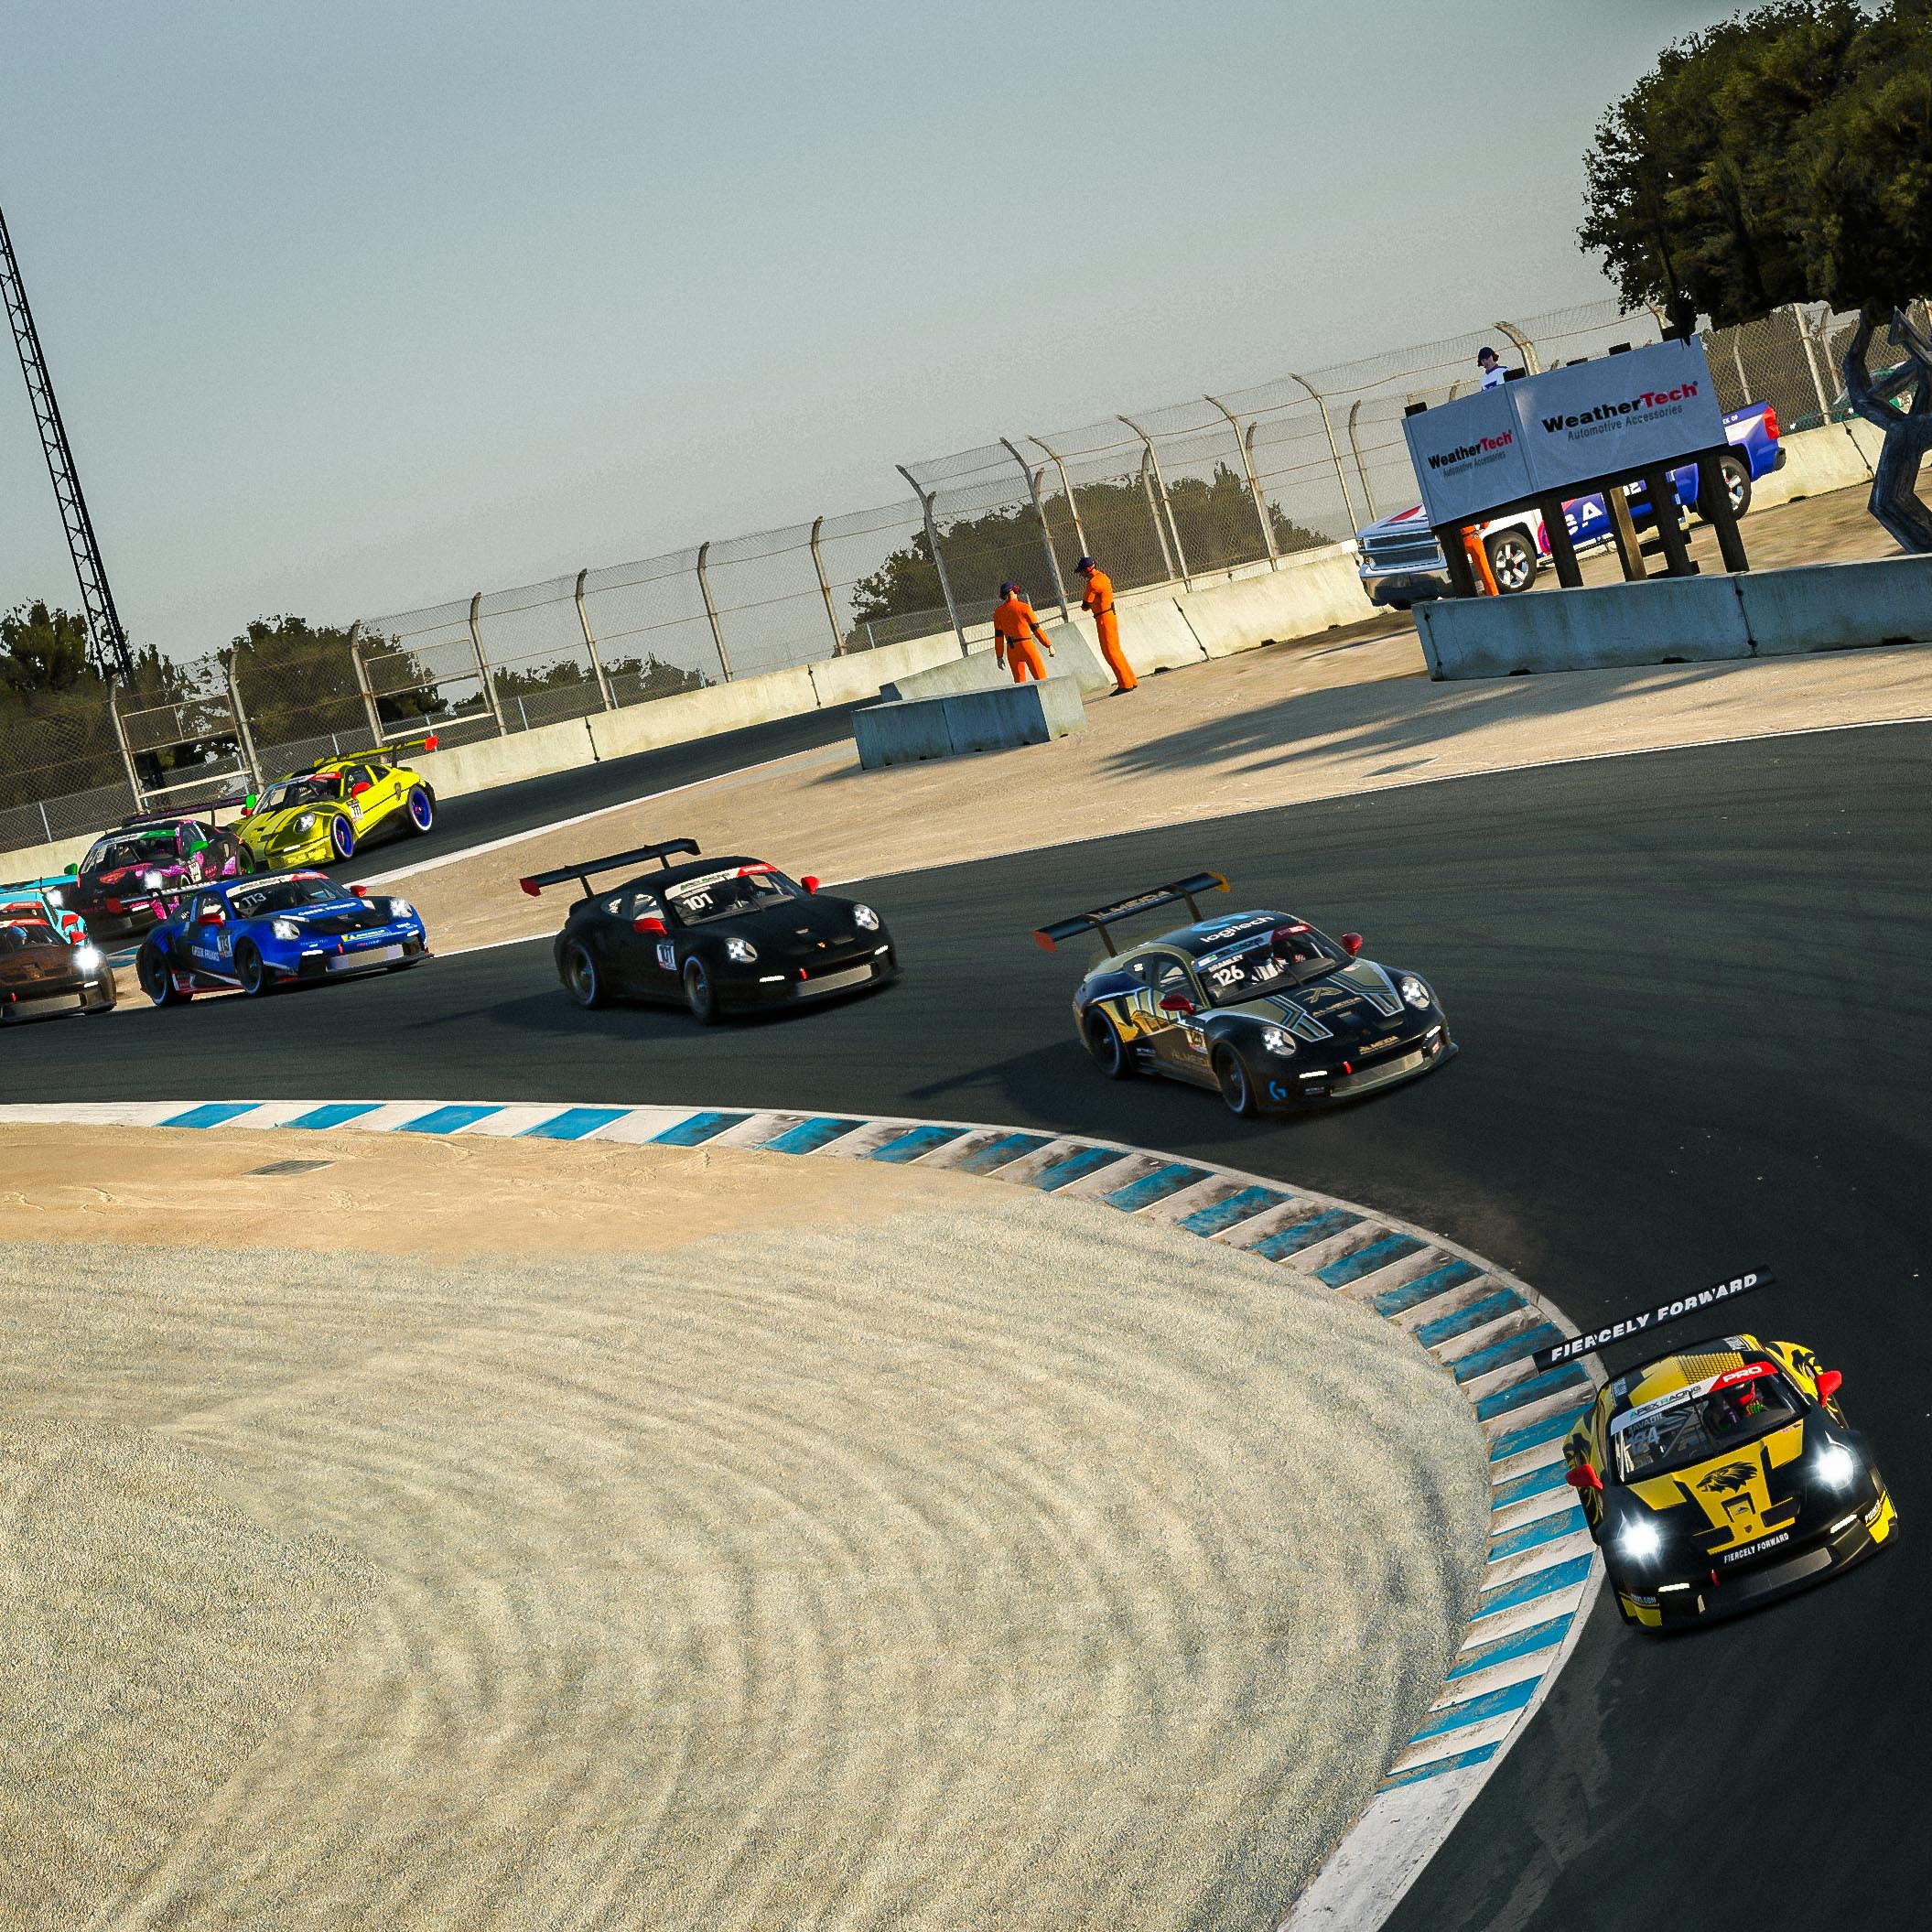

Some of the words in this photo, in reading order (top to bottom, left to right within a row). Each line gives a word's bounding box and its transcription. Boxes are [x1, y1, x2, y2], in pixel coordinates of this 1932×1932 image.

[1542, 383, 1697, 433] WeatherTech
[1568, 421, 1622, 441] Automotive
[1625, 404, 1683, 426] Accessories
[1428, 430, 1512, 470] WeatherTech
[1443, 462, 1473, 478] Automotive
[1473, 449, 1506, 468] Accessories
[683, 893, 713, 911] 101
[1200, 916, 1275, 943] logitech
[1213, 965, 1245, 987] 126
[1551, 1312, 1650, 1362] FIERCELY
[1657, 1273, 1757, 1321] FORWARD
[1722, 1365, 1763, 1384] PRO
[1629, 1400, 1658, 1420] APEX
[1657, 1385, 1702, 1407] RACING
[1724, 1545, 1755, 1564] FIERCELY
[1757, 1532, 1789, 1552] FORWARD
